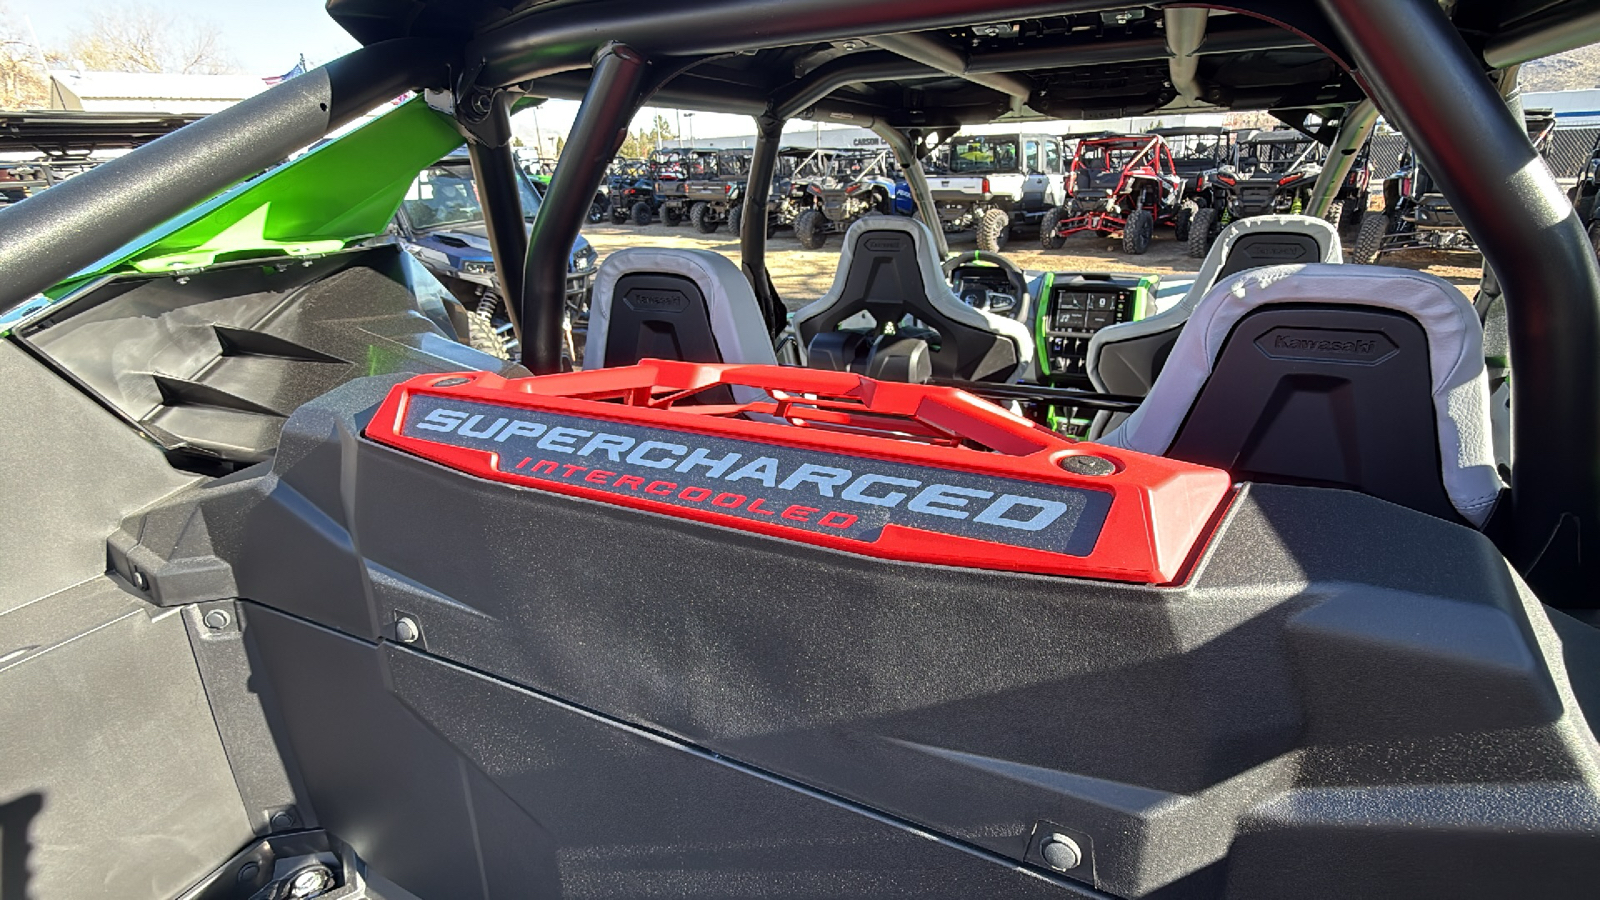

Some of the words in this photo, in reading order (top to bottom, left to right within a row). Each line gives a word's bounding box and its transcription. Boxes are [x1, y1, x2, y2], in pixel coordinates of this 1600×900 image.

[853, 137, 879, 146] CARSON
[1273, 334, 1377, 354] Kawasaki
[416, 408, 1067, 531] SUPERCHARGED
[515, 457, 858, 529] INTERCOOLED
